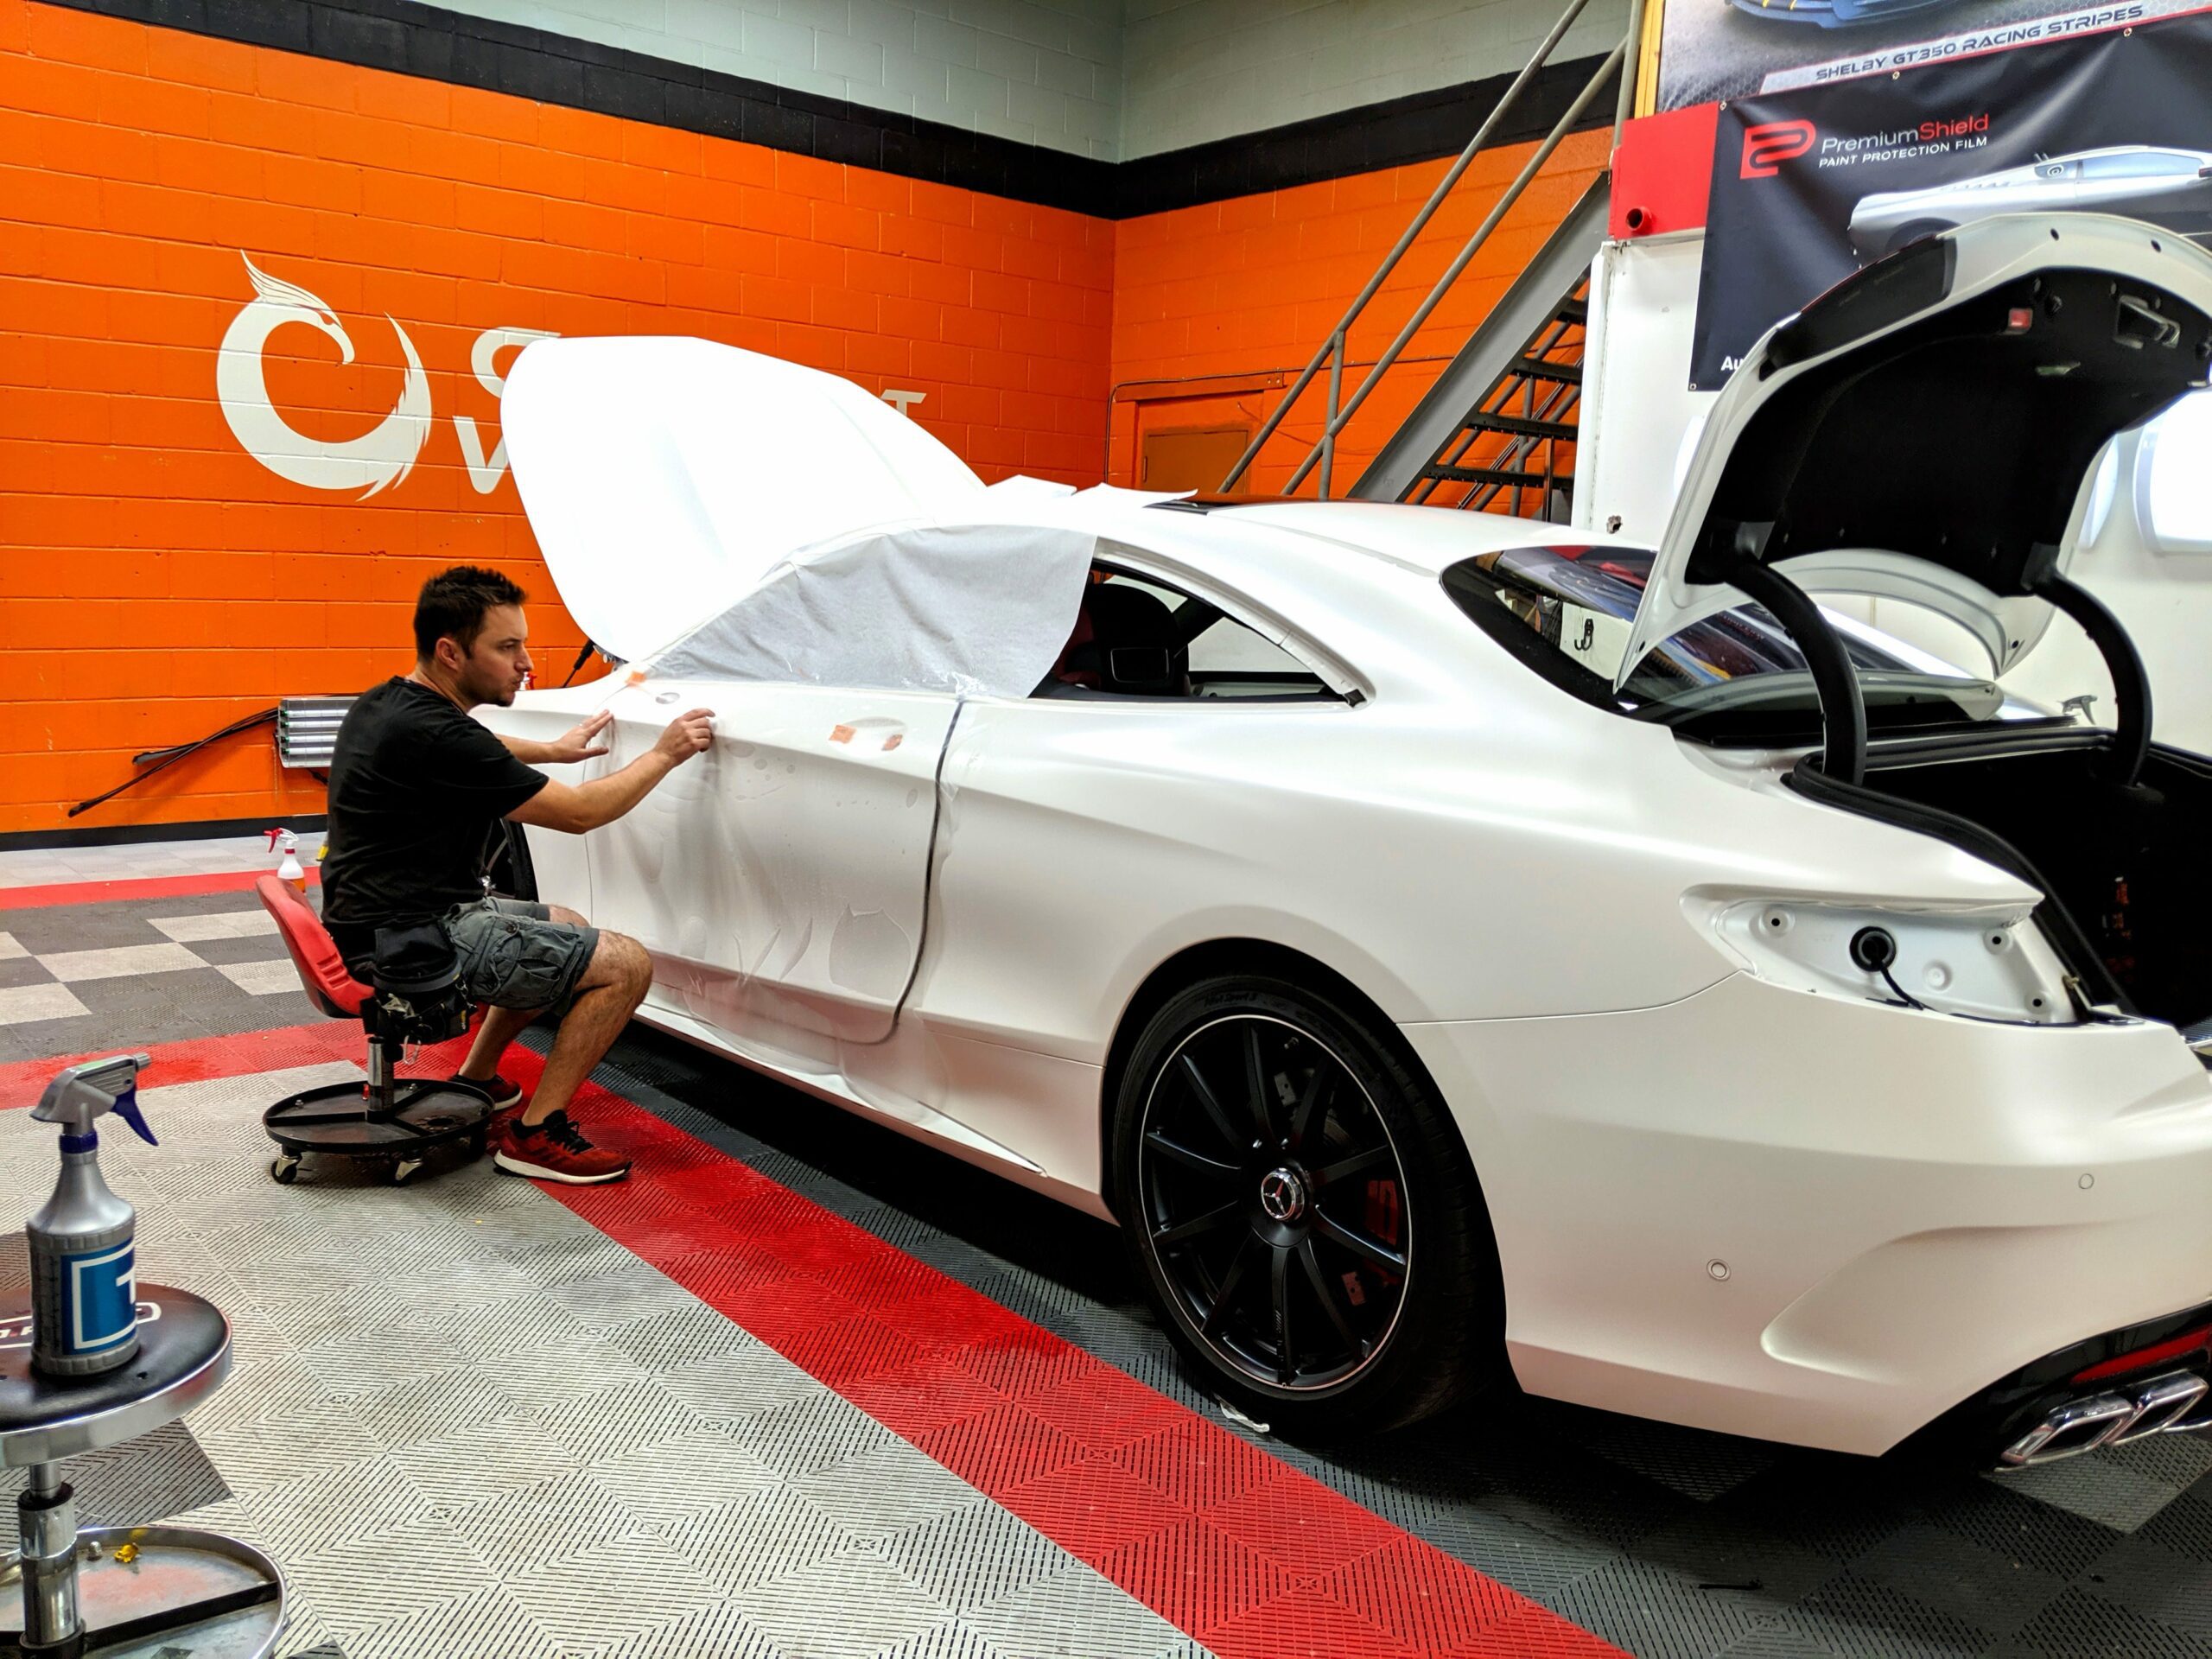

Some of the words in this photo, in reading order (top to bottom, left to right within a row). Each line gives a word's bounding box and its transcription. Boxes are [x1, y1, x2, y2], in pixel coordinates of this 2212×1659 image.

[1816, 56, 1887, 81] SHELBY
[1892, 42, 1956, 65] GT350
[1962, 21, 2041, 52] RACING
[2047, 5, 2143, 36] STRIPES
[1819, 154, 1857, 168] PAINT
[1862, 143, 1949, 163] PROTECTION
[1955, 136, 1987, 150] FILM
[1821, 113, 1988, 154] PremiumShield
